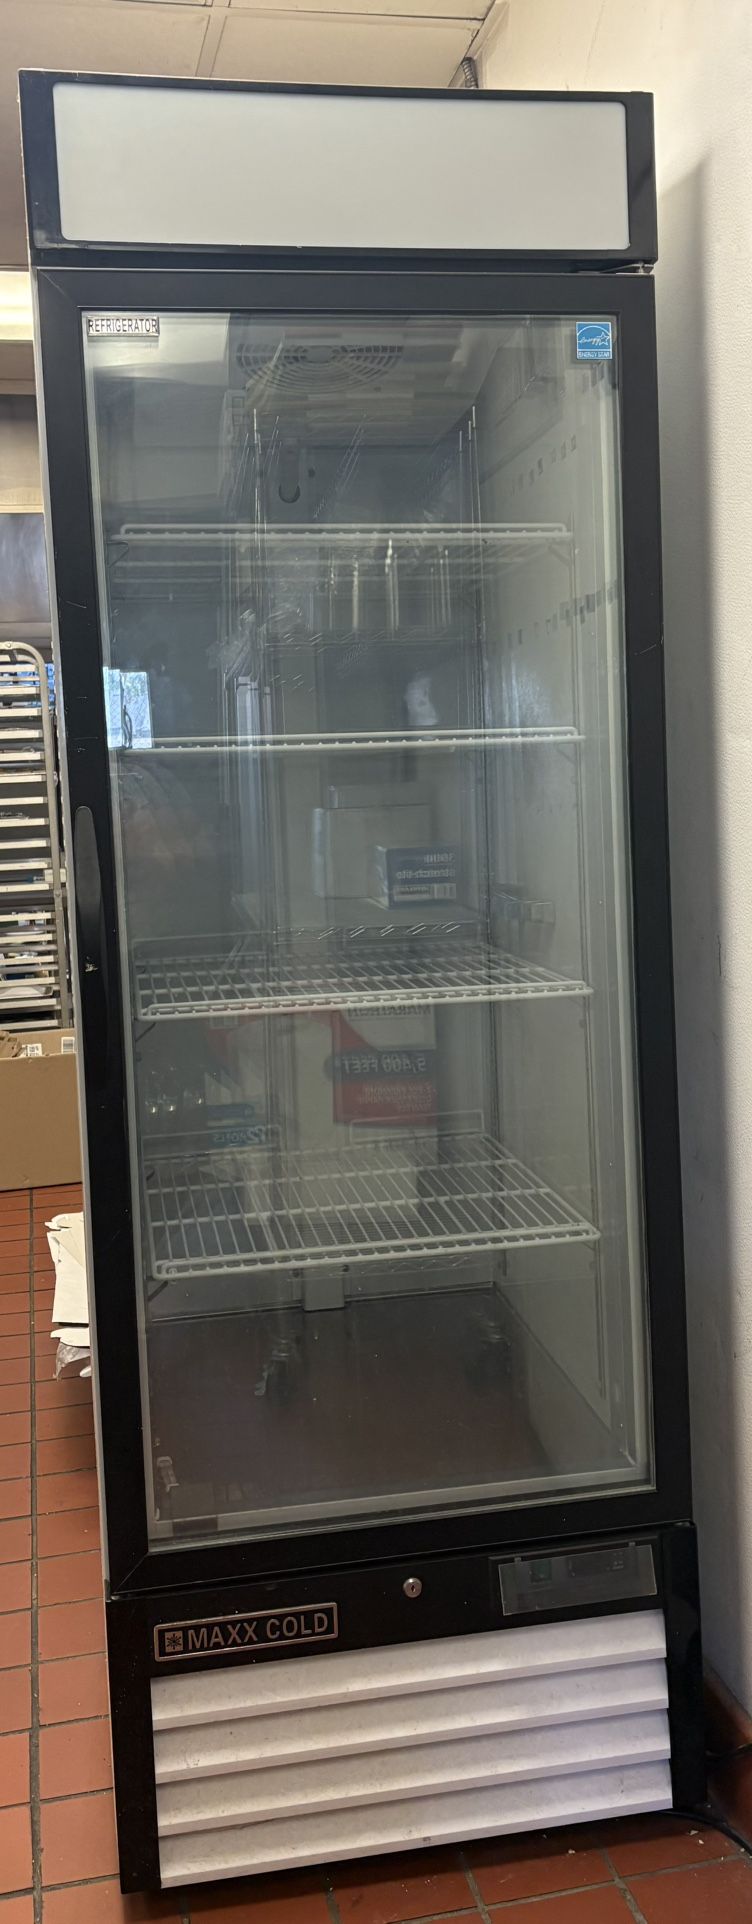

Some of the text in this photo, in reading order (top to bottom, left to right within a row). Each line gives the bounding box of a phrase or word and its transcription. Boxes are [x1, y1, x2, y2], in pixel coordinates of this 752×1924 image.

[87, 318, 158, 332] REFRIGERATOR
[187, 1612, 329, 1651] MAXX COLD
